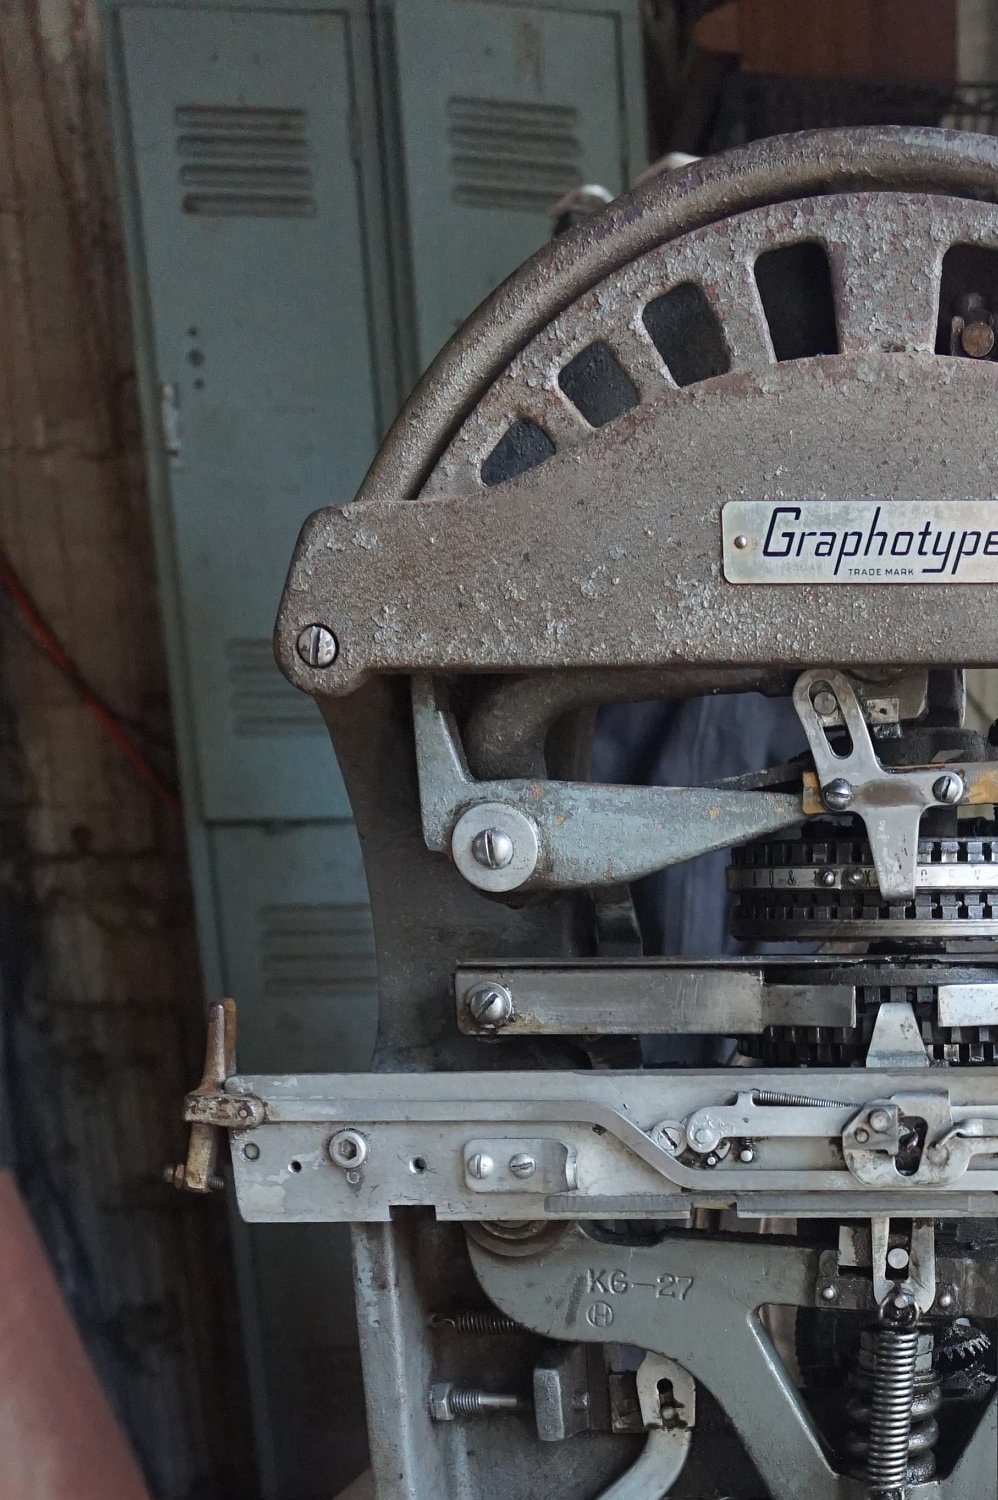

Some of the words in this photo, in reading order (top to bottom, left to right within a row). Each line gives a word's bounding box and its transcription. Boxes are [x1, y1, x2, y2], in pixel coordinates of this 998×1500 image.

[848, 568, 882, 576] TRADE
[885, 568, 914, 576] MARK
[586, 1267, 695, 1301] KG-27
